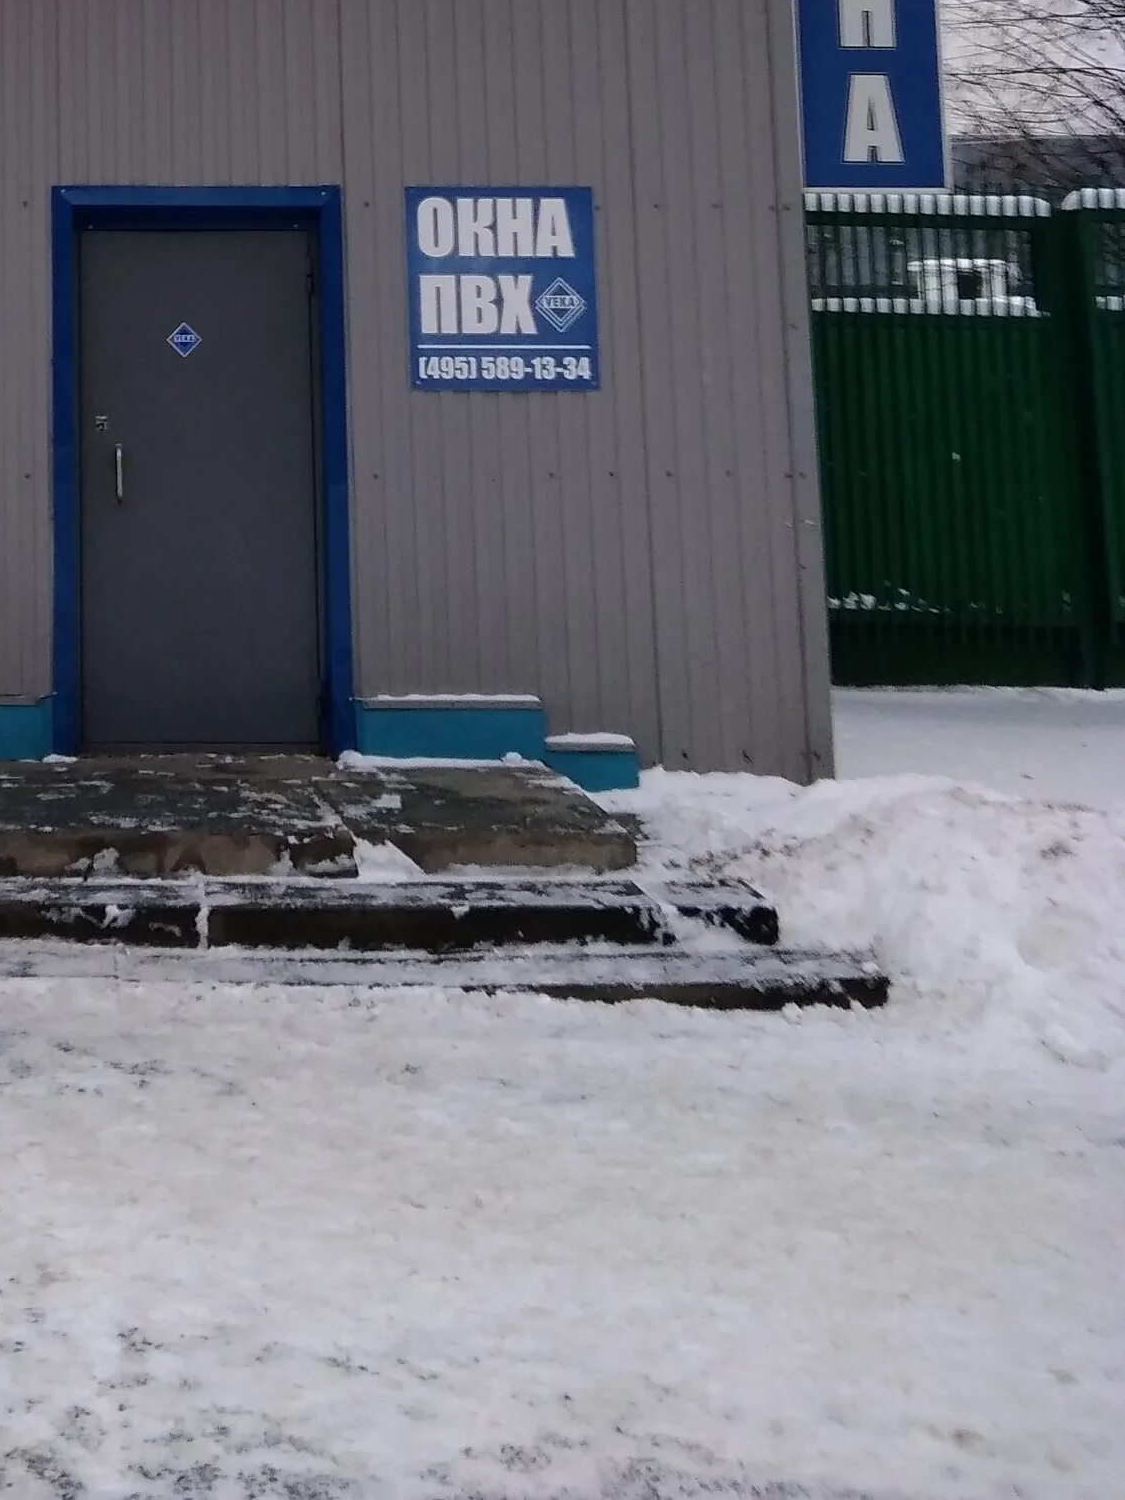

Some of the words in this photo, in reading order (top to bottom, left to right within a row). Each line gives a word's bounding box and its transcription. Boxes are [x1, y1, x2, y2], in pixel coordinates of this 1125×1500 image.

[418, 197, 575, 257] ОКНА
[419, 274, 539, 334] ПВХ
[544, 296, 576, 308] VEKA
[481, 356, 591, 380] 589-13-34
